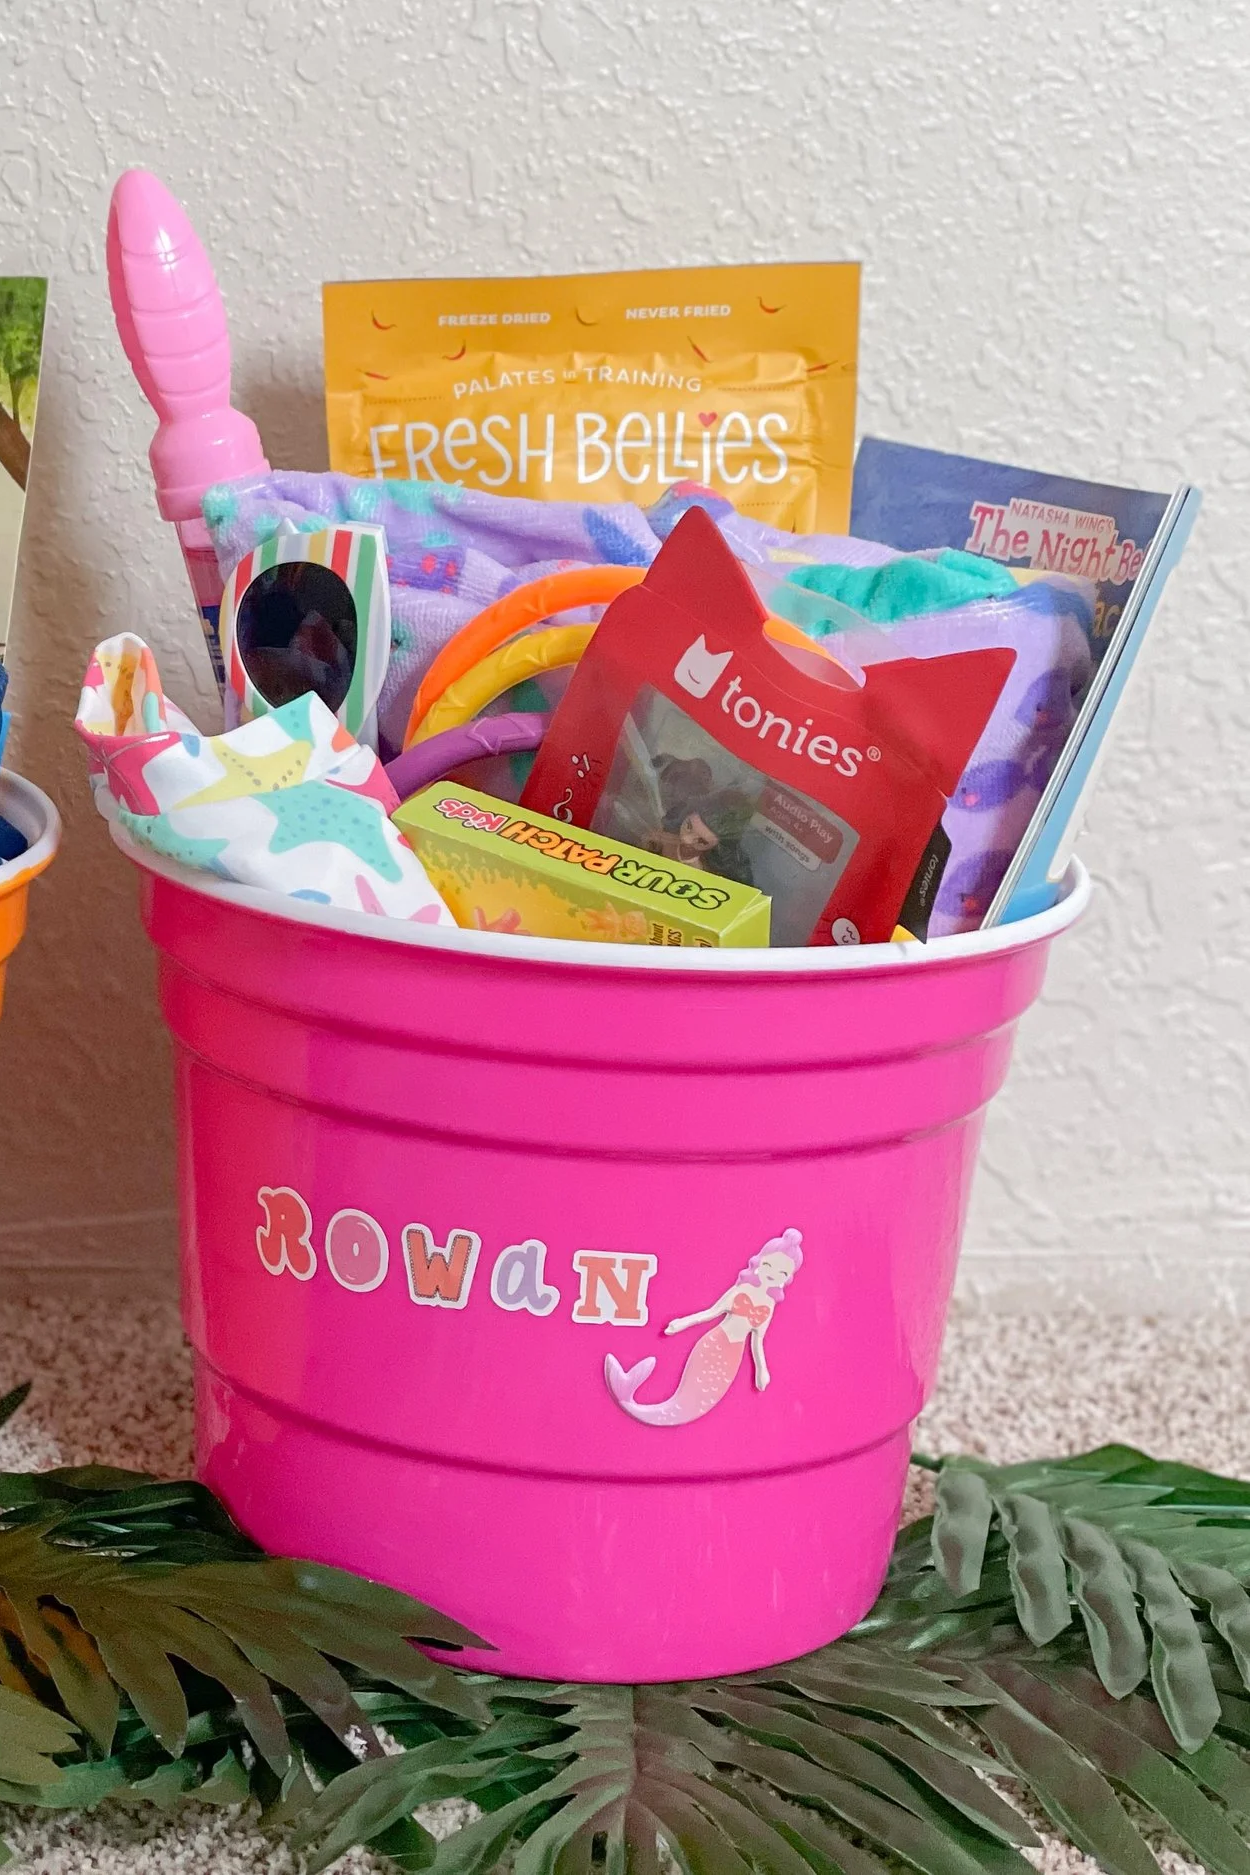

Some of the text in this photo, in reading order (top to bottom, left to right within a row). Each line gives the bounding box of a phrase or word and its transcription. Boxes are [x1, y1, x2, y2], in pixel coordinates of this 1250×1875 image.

[438, 312, 551, 327] FREEZE DRIED
[625, 304, 732, 320] NEVER FRIED
[453, 364, 703, 400] PALATES in TRAINING
[1010, 501, 1115, 534] NATASHA WING'S
[967, 504, 1031, 557] The
[1035, 528, 1118, 581] Night
[773, 793, 834, 844] Audio Play
[432, 797, 731, 911] SOUR PATCH Kids
[764, 824, 811, 863] with songs
